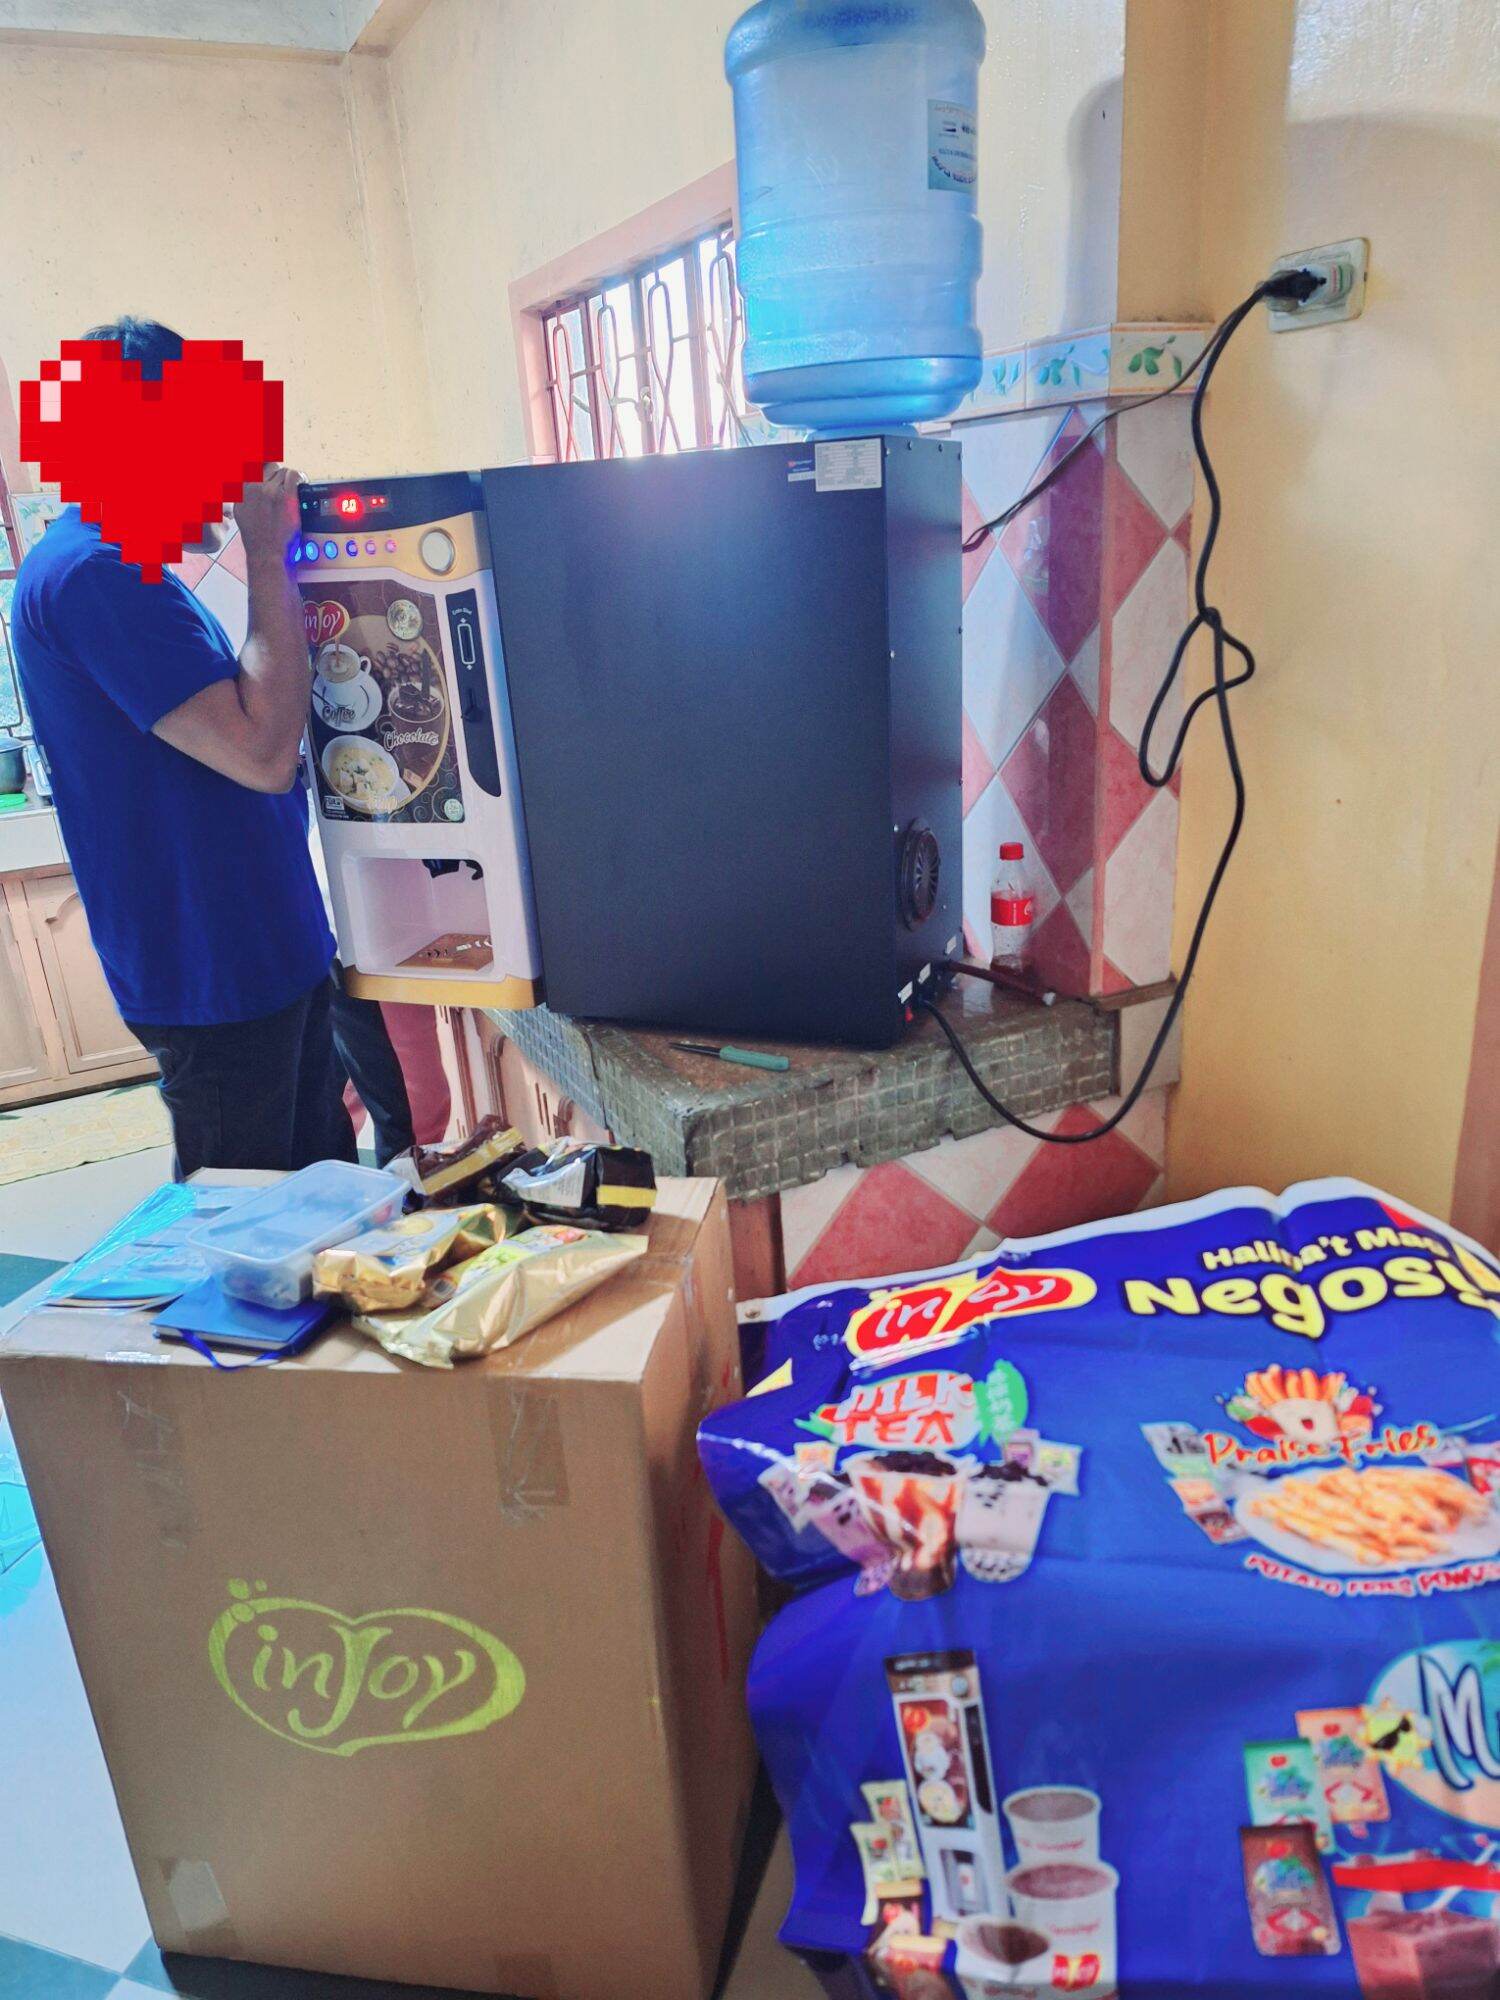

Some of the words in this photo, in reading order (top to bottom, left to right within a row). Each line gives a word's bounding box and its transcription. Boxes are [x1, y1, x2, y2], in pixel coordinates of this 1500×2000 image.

[384, 727, 440, 751] Chocolate
[1202, 1235, 1352, 1272] Halia't
[838, 1409, 955, 1446] TEA
